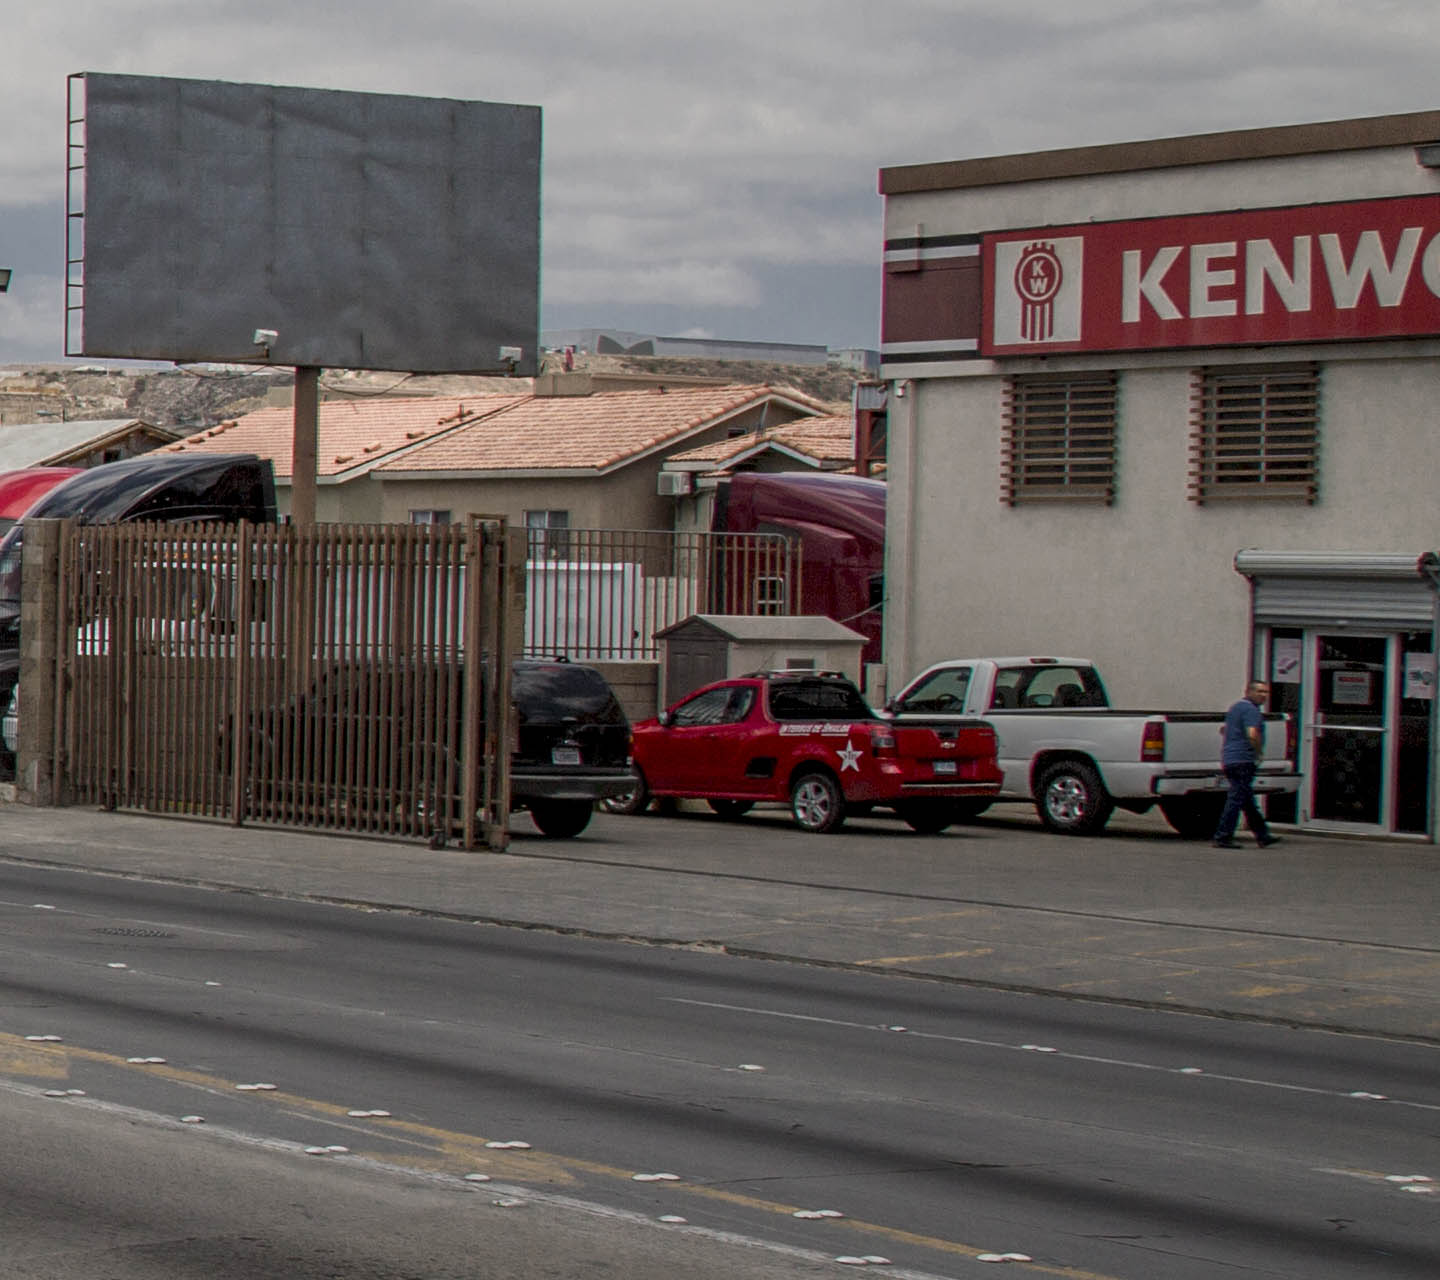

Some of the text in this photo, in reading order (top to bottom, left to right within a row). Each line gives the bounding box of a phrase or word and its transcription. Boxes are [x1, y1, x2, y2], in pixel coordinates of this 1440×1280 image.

[1032, 260, 1045, 276] K
[1121, 227, 1440, 324] KENW
[1029, 277, 1047, 294] W
